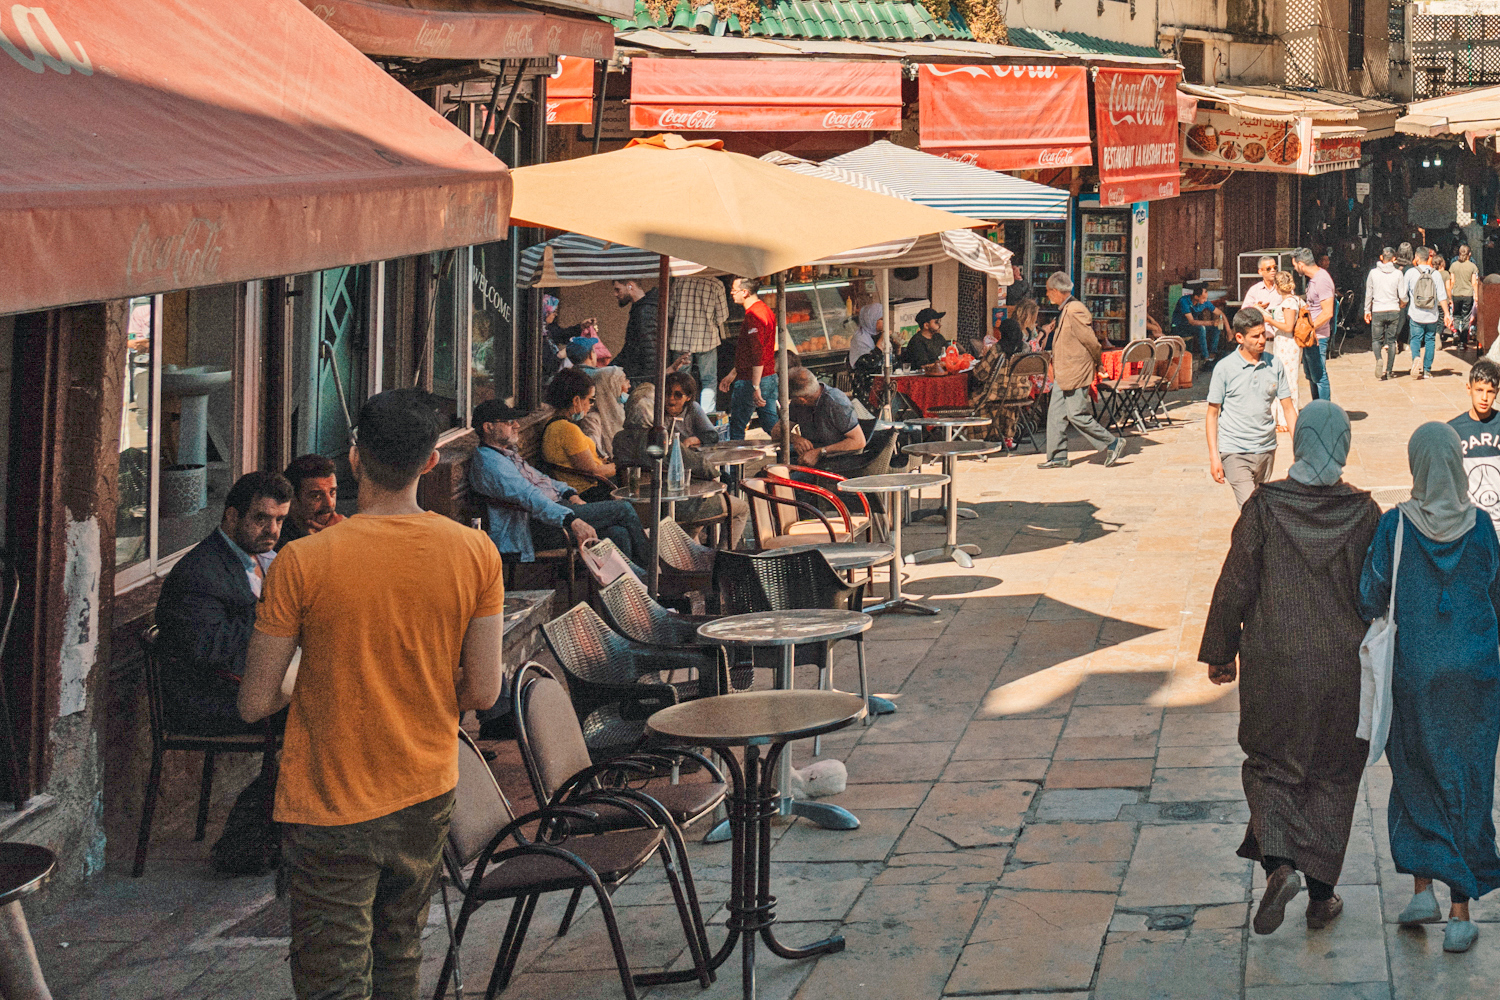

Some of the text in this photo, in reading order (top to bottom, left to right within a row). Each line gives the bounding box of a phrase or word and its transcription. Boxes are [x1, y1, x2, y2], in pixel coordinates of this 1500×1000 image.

[1108, 73, 1167, 127] Coca-Cola
[658, 108, 720, 129] Coca-Cola
[822, 110, 877, 129] Coca-Cola
[1038, 149, 1074, 166] Coca-Cola
[1103, 145, 1136, 171] RESTAURANT
[1135, 144, 1142, 167] LA
[472, 264, 512, 324] WELCOME
